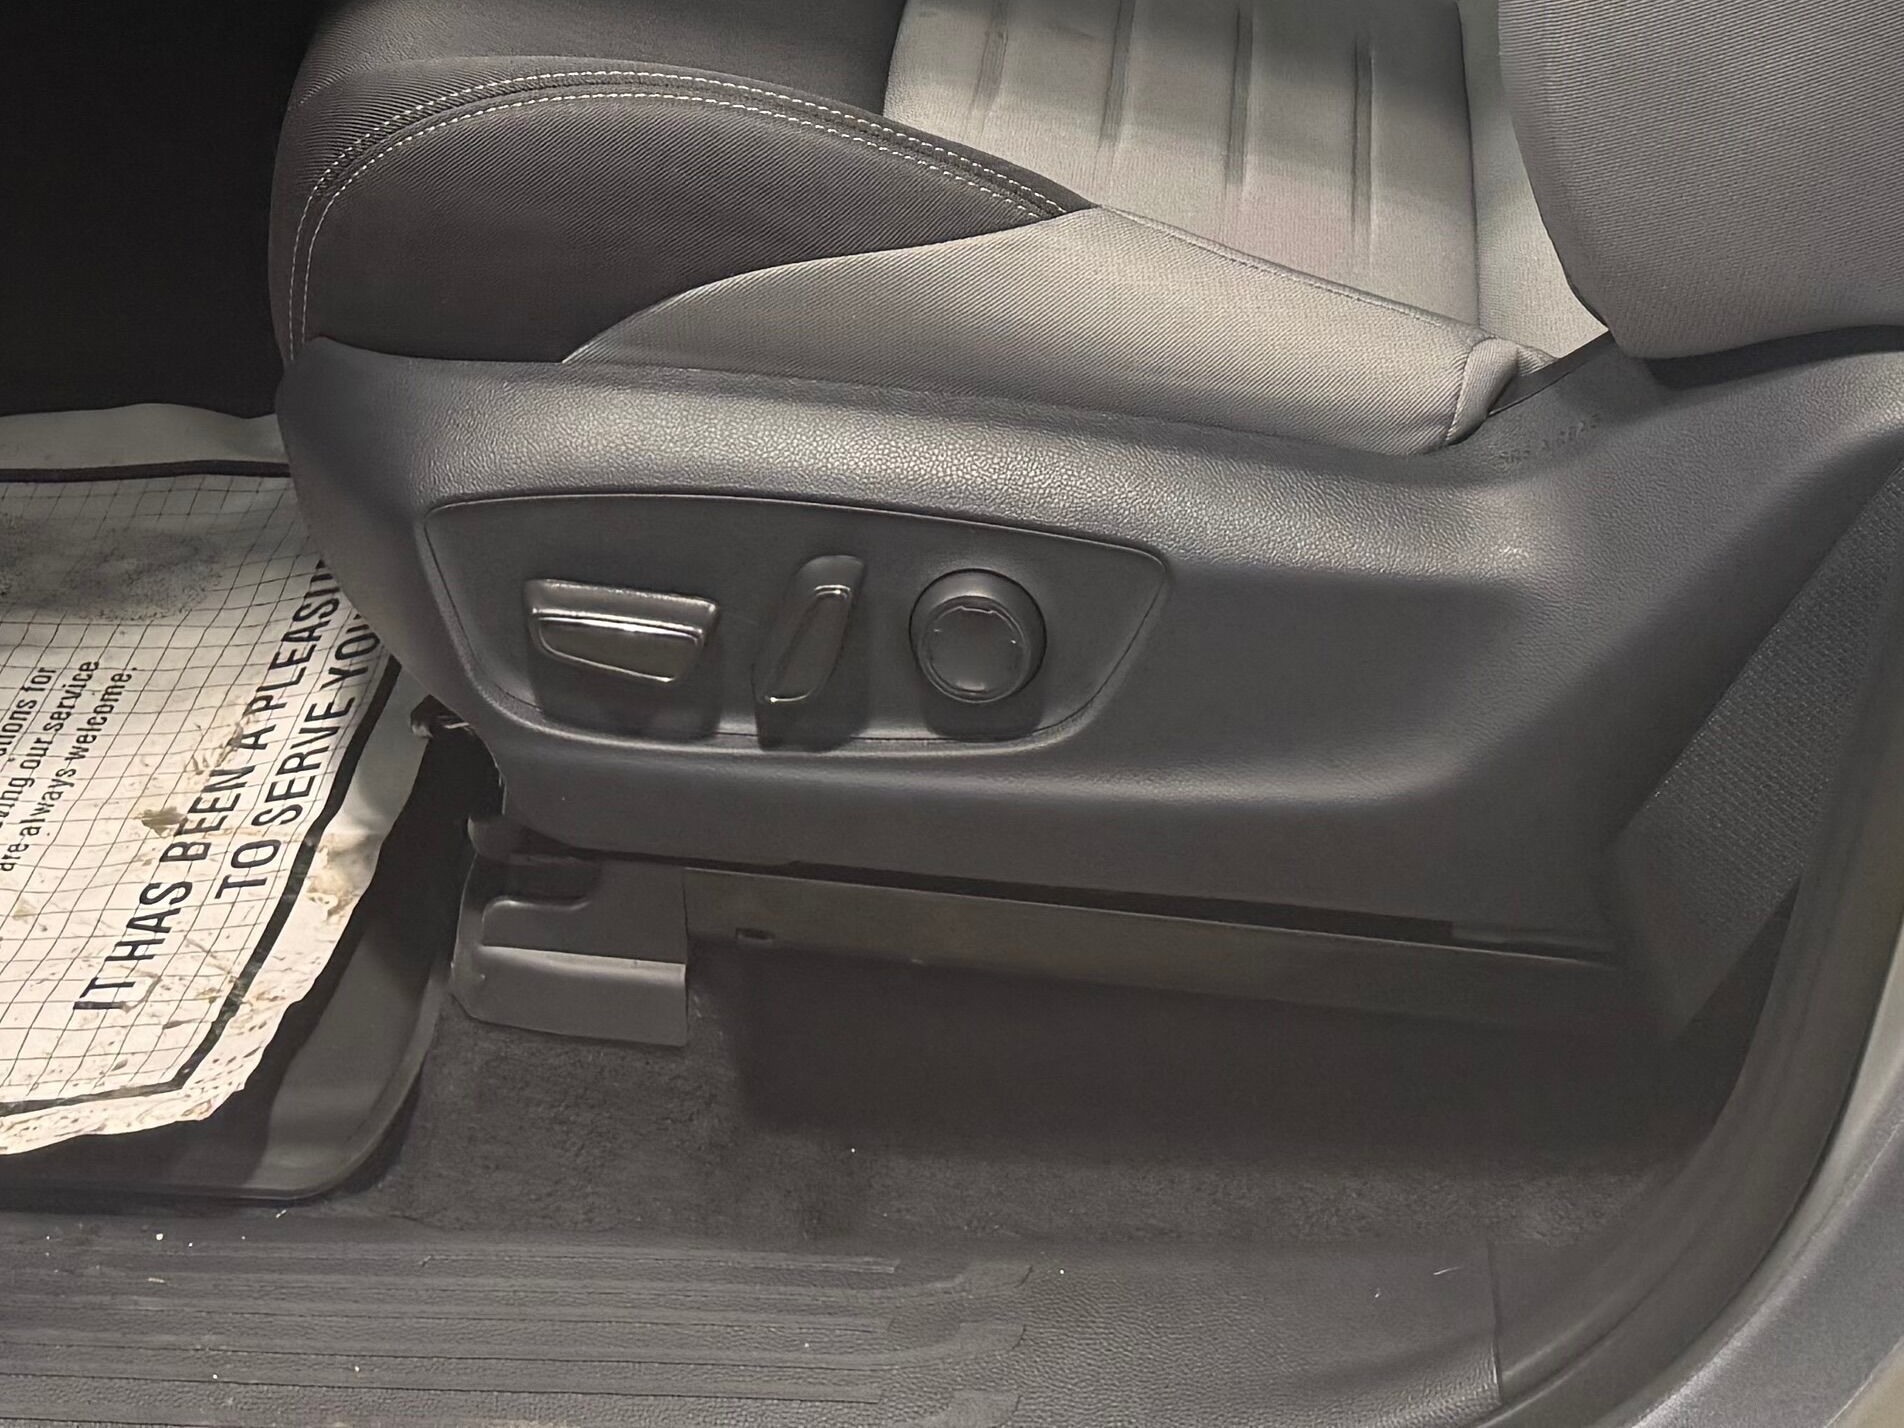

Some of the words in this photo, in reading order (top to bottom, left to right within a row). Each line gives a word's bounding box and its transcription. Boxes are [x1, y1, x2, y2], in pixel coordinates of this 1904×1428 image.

[19, 736, 54, 771] our
[43, 661, 99, 732] service
[21, 667, 57, 693] for
[19, 766, 77, 837] always
[215, 837, 282, 902] TO
[252, 693, 358, 826] SERVE
[73, 975, 135, 1011] IT
[107, 880, 193, 963] HAS
[160, 767, 256, 864] BEEN
[238, 724, 270, 752] A
